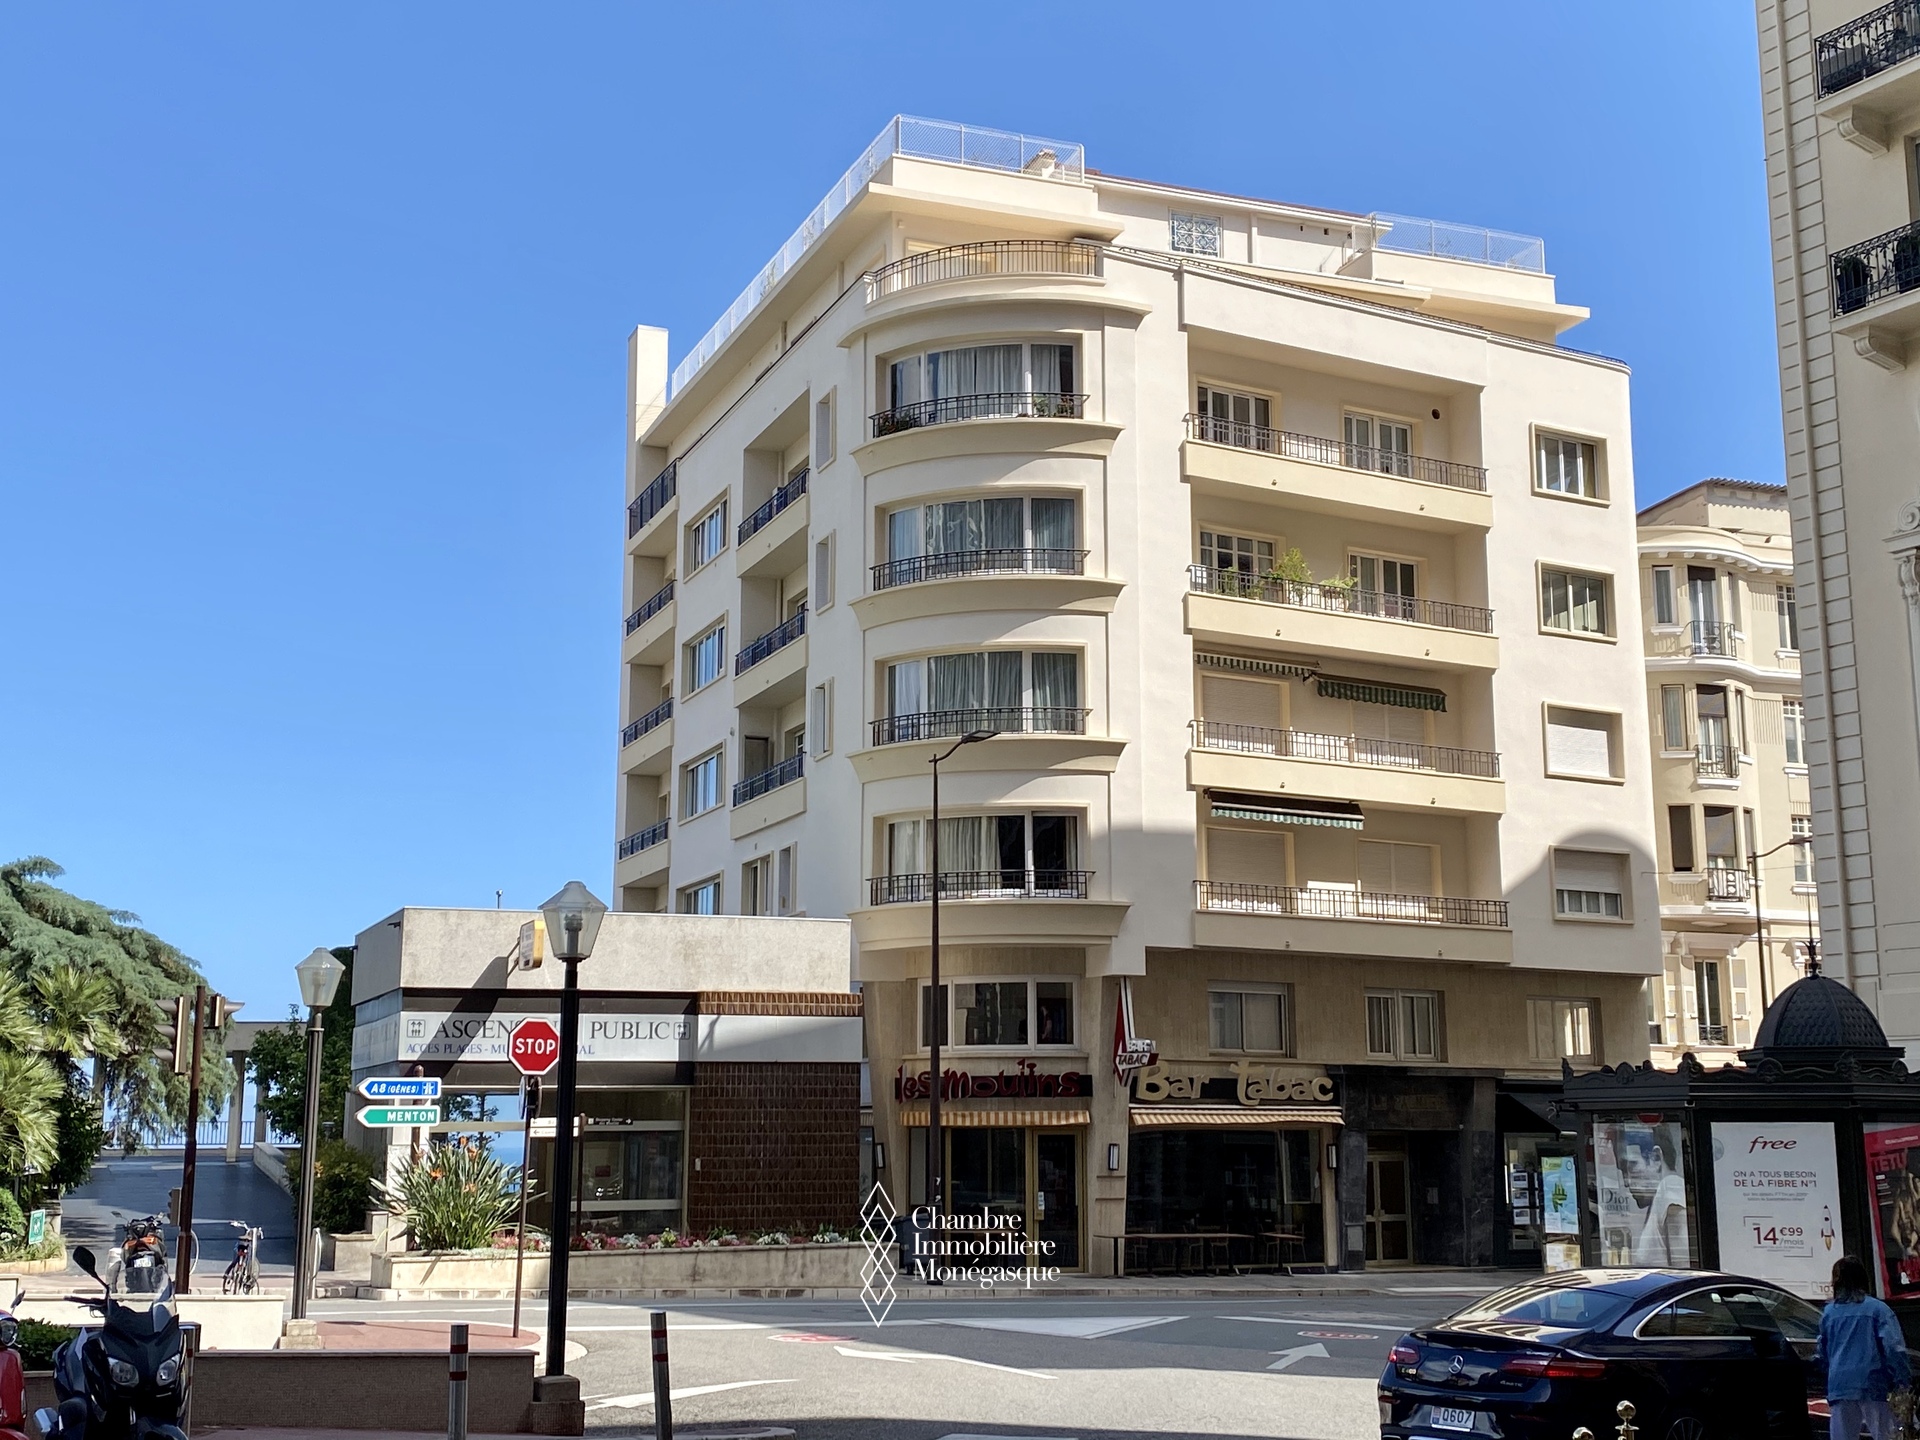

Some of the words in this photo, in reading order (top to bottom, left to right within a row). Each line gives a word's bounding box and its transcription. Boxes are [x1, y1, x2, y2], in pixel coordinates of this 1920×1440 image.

[590, 1021, 670, 1039] PUBLIC
[443, 1043, 481, 1054] PLAGES
[515, 1037, 556, 1055] STOP
[1117, 1053, 1148, 1065] TABAC
[370, 1083, 387, 1094] A8
[387, 1083, 420, 1094] (GÊNES)
[1136, 1060, 1210, 1102] Bar
[1230, 1060, 1334, 1106] tabac
[387, 1111, 435, 1122] MENTON
[1748, 1135, 1798, 1154] free
[1733, 1170, 1747, 1178] ON
[1749, 1170, 1756, 1178] A
[1758, 1170, 1782, 1178] TOUS
[1783, 1170, 1817, 1178] BESOIN
[1734, 1179, 1748, 1187] DE
[1751, 1179, 1764, 1187] LA
[1768, 1179, 1798, 1187] FIBRE
[1601, 1188, 1630, 1204] Dior
[1753, 1226, 1779, 1245] 14
[1442, 1408, 1472, 1425] Q607
